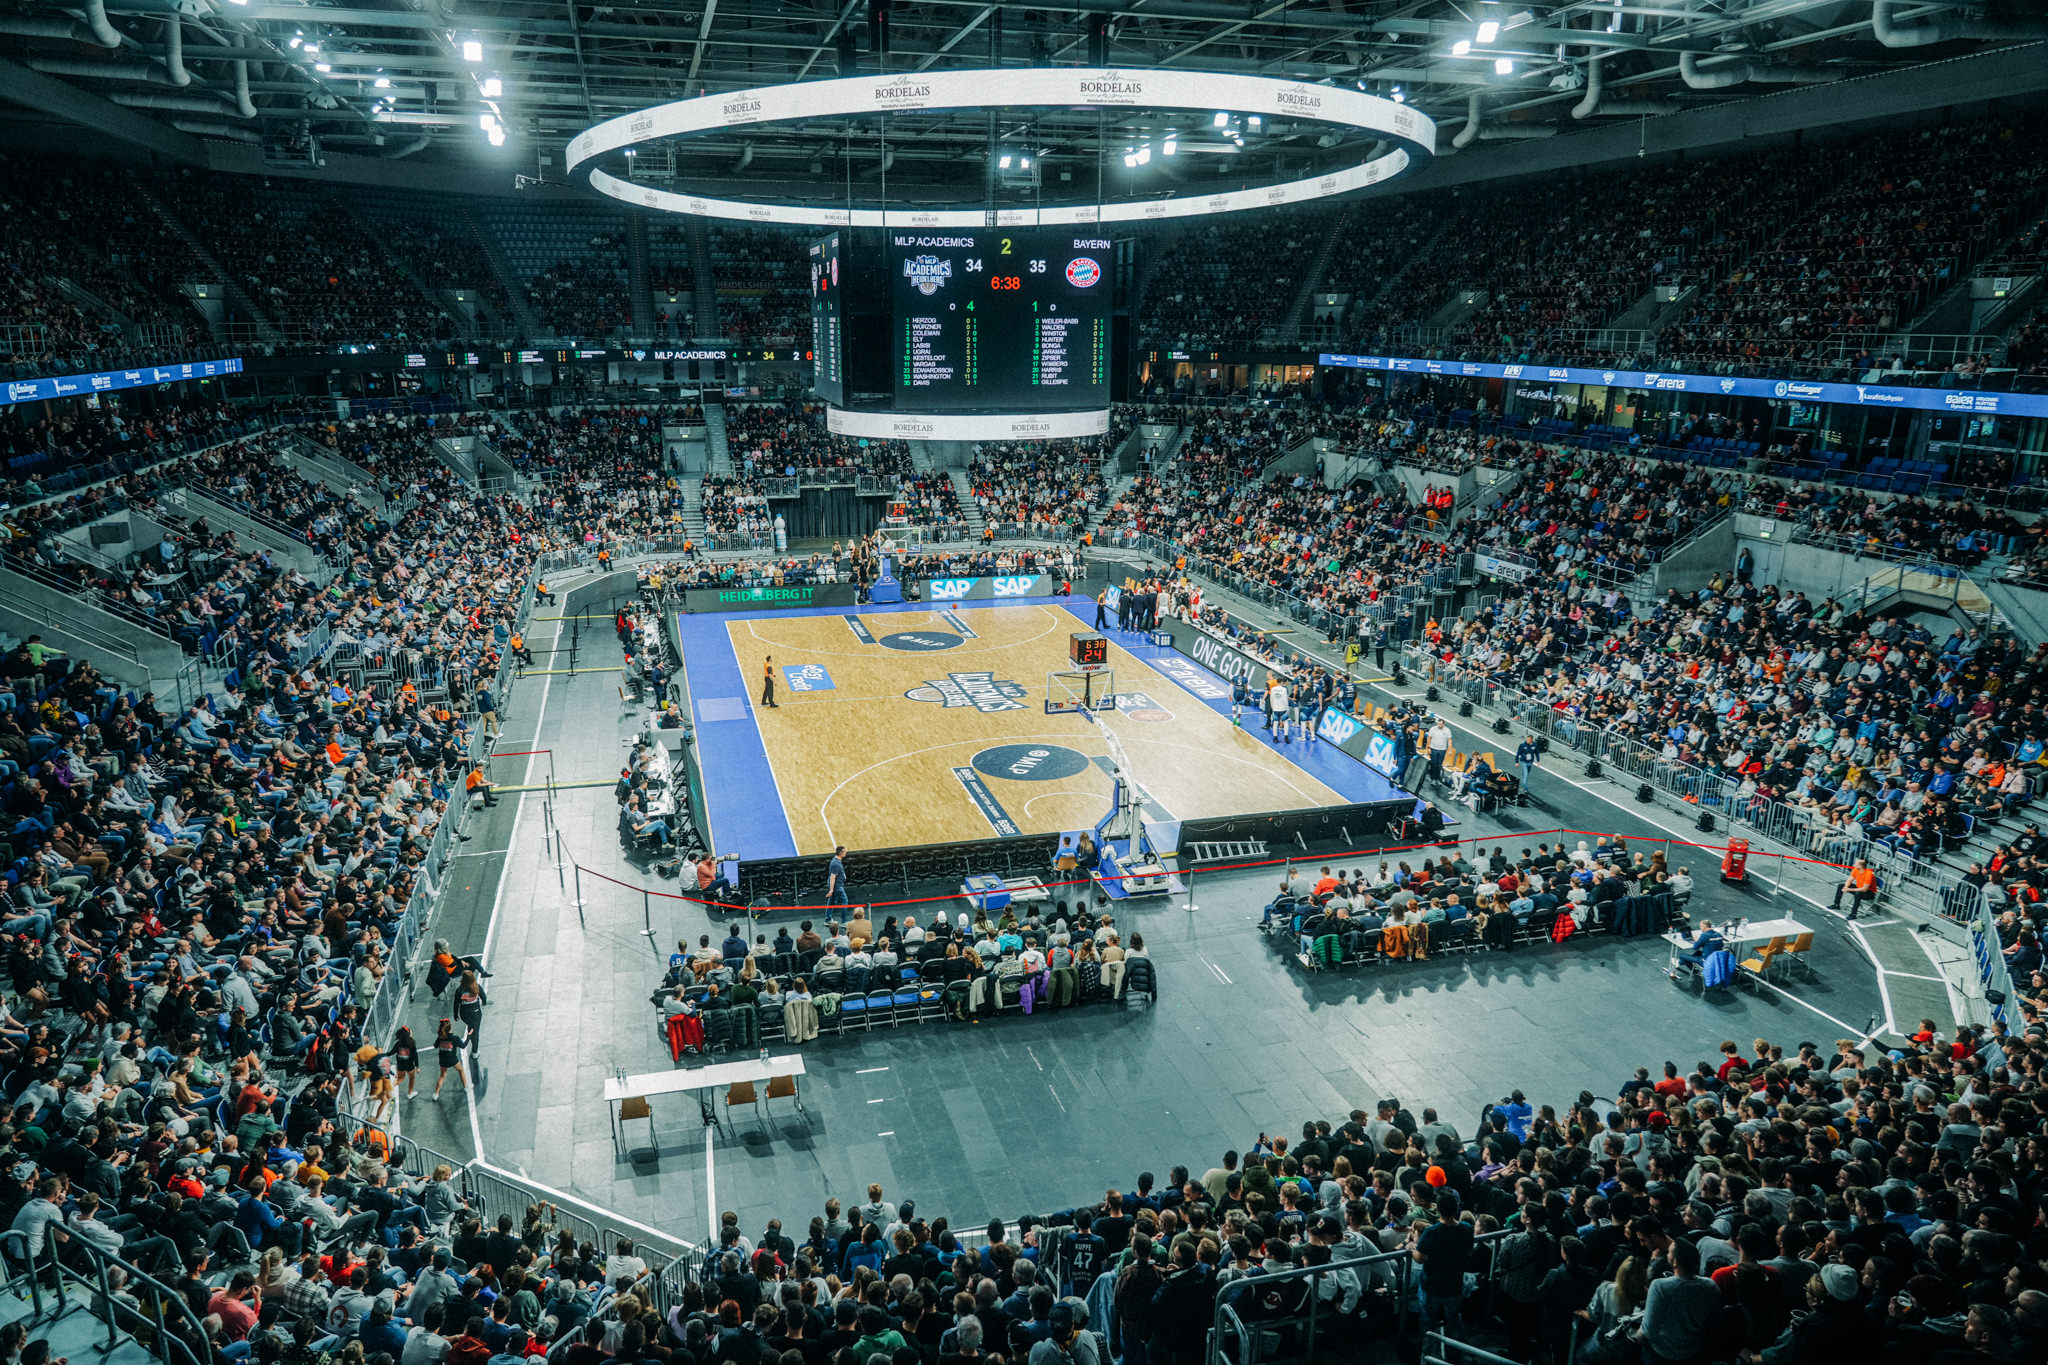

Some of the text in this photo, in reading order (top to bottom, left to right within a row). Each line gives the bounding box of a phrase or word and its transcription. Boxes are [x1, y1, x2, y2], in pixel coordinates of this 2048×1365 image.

[875, 86, 930, 98] BORDELAIS
[1080, 82, 1142, 94] BORDELAIS
[1277, 92, 1321, 108] BORDELAIS
[723, 101, 762, 115] BORDELAIS
[894, 236, 974, 247] MLP ACADEMICS
[1000, 238, 1012, 254] 2
[1074, 239, 1111, 249] BAYERN
[905, 262, 950, 276] ACADEMICS
[966, 258, 983, 272] 34
[1029, 260, 1046, 273] 35
[1076, 258, 1098, 271] BAYERN
[991, 276, 1020, 290] 6:38
[966, 301, 974, 312] 4
[1032, 301, 1038, 312] 1
[674, 351, 726, 360] ACADEMICS
[763, 352, 775, 360] 34
[793, 352, 800, 360] 2
[1656, 378, 1685, 389] arena
[1788, 383, 1824, 394] Ensinger
[894, 423, 934, 432] BORDELAIS
[1011, 423, 1050, 432] BORDELAIS
[930, 580, 971, 598] SAP
[992, 577, 1032, 595] SAP
[720, 587, 800, 602] HEIDELBERG
[1107, 586, 1120, 609] SA
[1084, 649, 1102, 661] 24
[1192, 636, 1222, 668] ONE
[788, 672, 812, 690] Credit
[1170, 670, 1226, 697] arena
[950, 673, 1024, 712] ACADEMICS
[1320, 711, 1354, 744] SAP
[1008, 756, 1042, 774] MLP
[1073, 1252, 1093, 1269] 47
